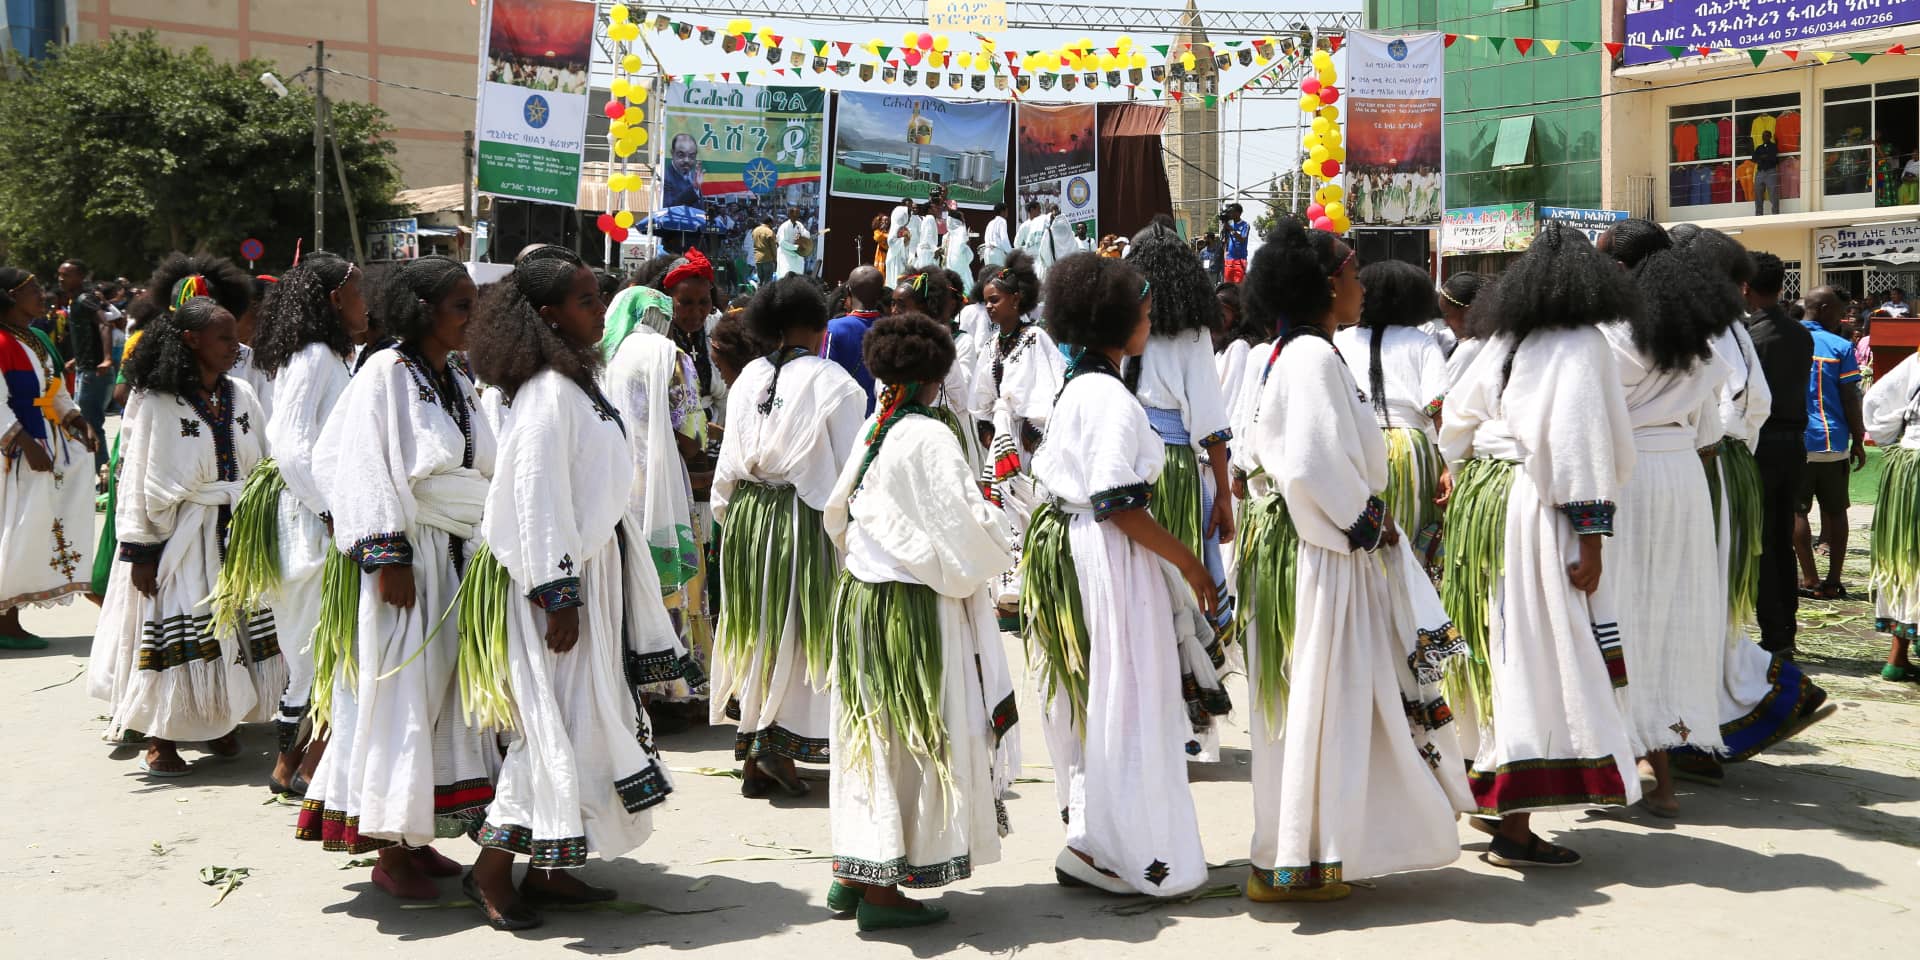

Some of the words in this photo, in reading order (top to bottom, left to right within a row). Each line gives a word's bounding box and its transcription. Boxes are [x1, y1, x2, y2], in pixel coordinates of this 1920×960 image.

[1739, 33, 1765, 45] 0344
[1768, 30, 1782, 40] 40
[1785, 27, 1799, 38] 57
[1801, 20, 1848, 35] 46/0344
[1850, 12, 1894, 27] 407266
[756, 88, 808, 112] በዓል
[1838, 239, 1885, 249] SHEBA
